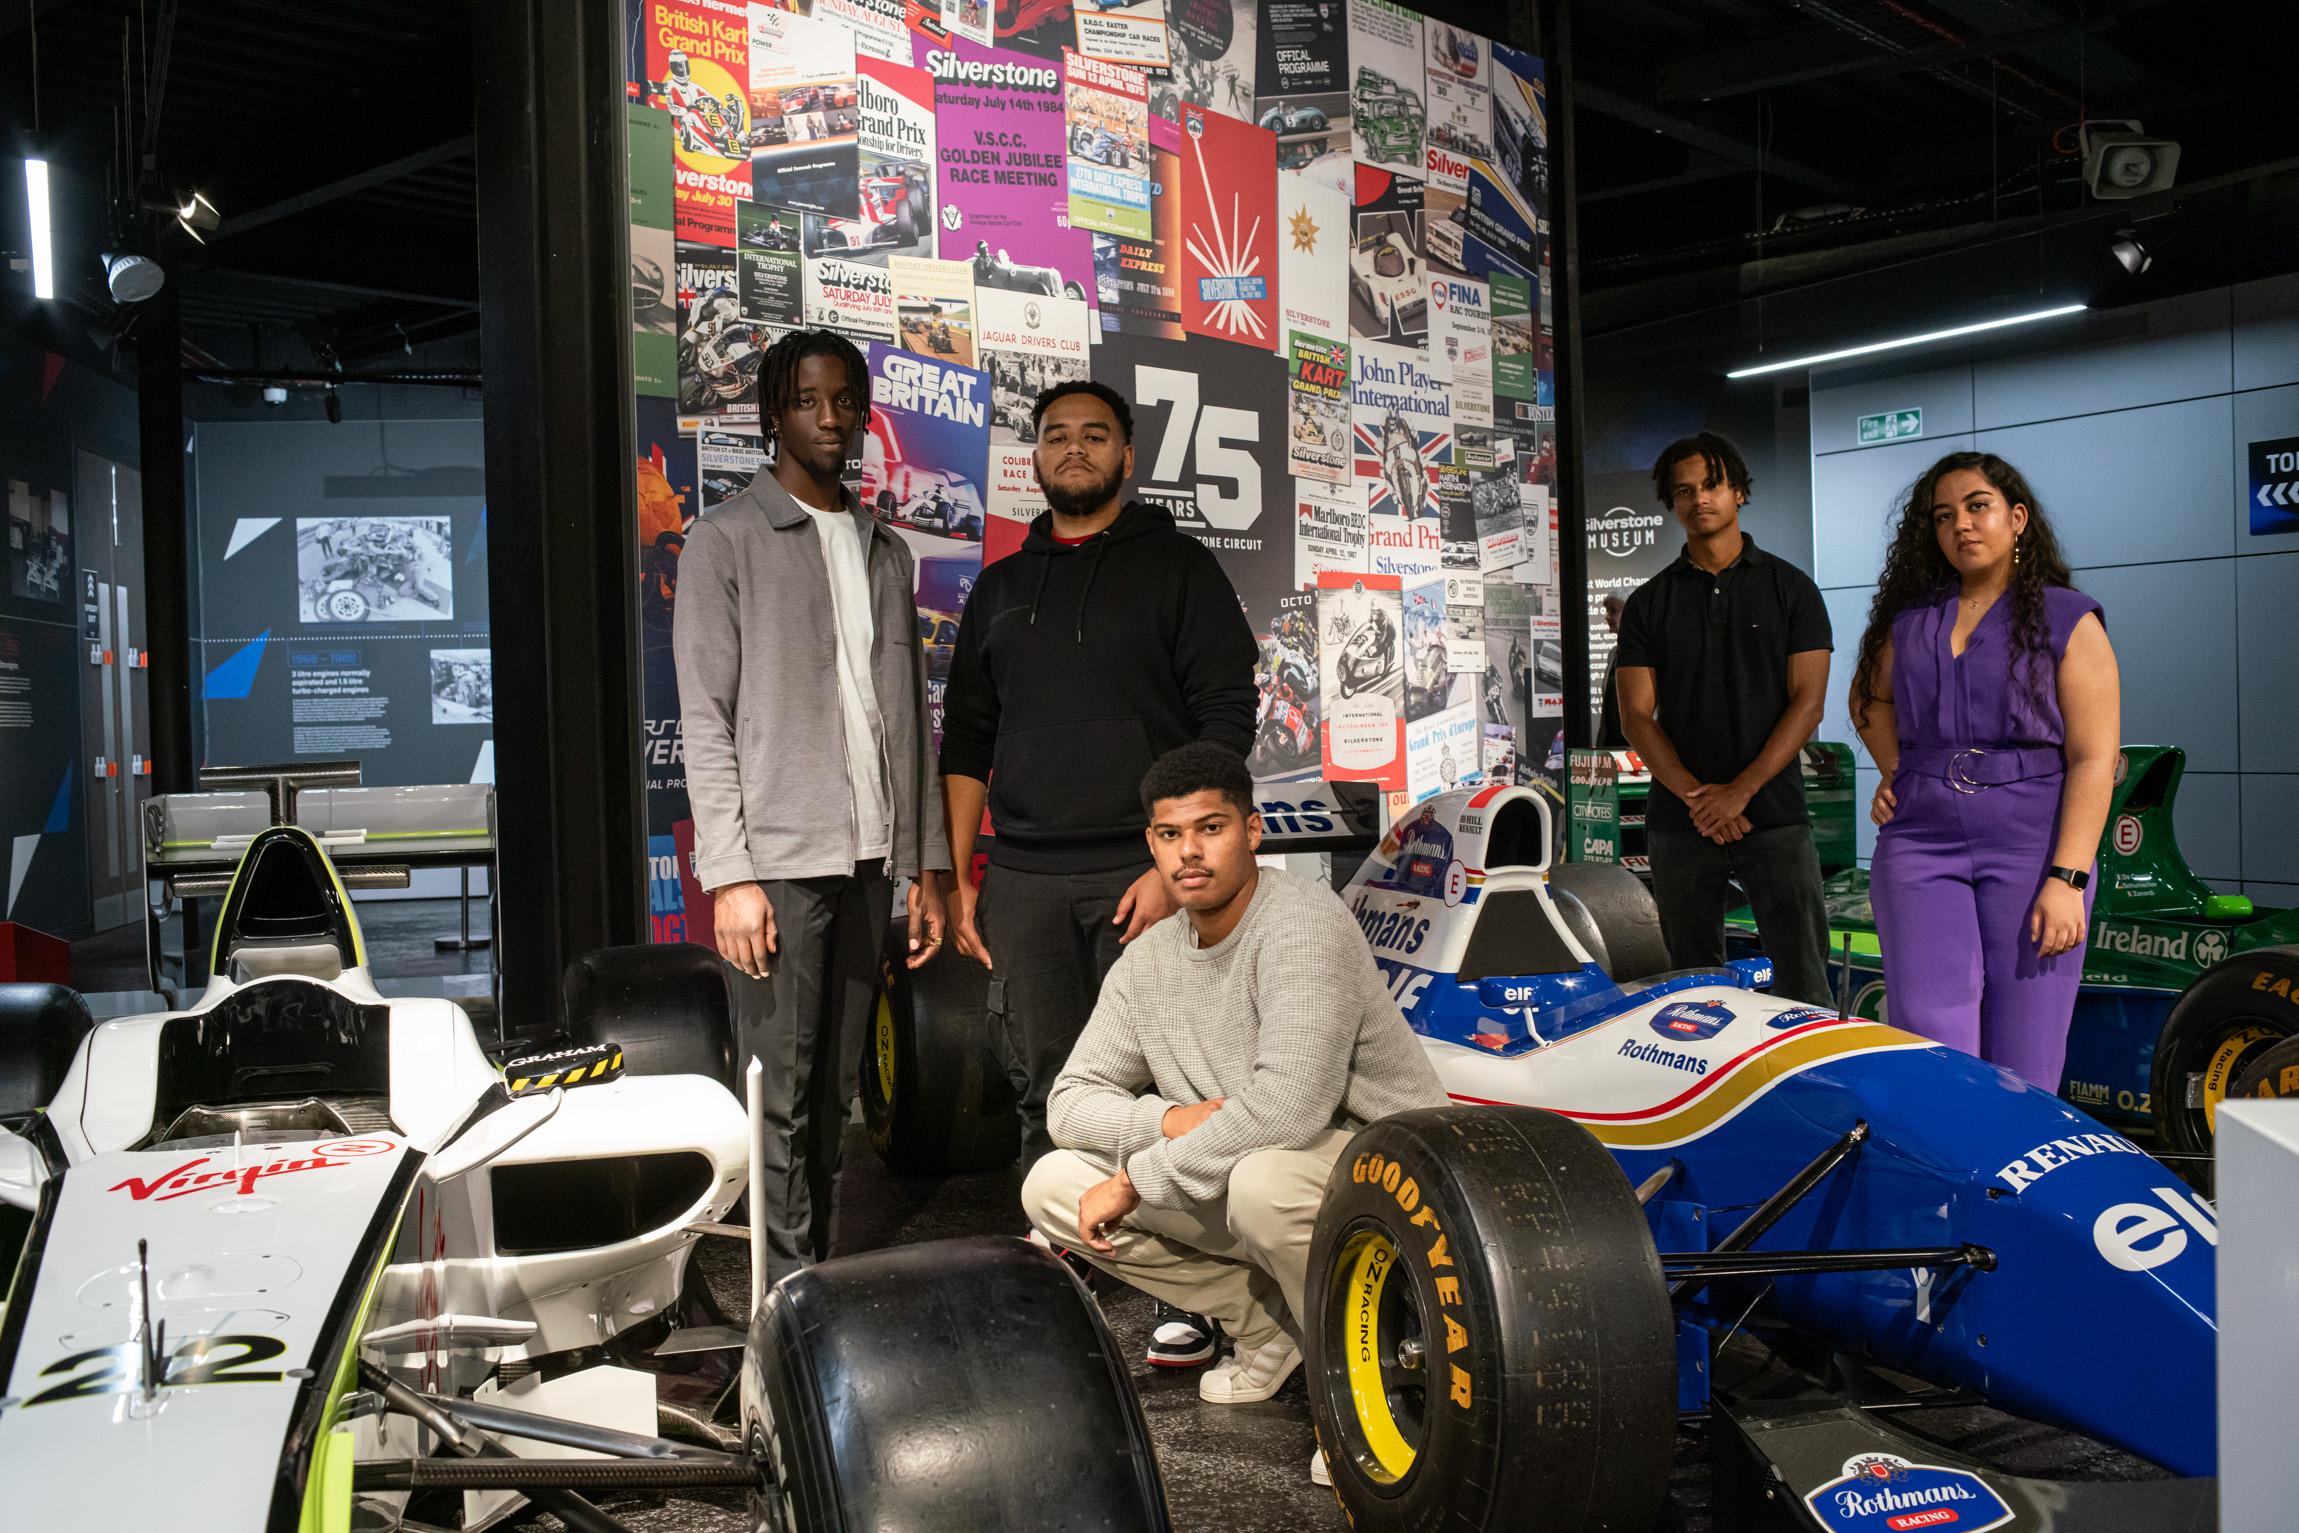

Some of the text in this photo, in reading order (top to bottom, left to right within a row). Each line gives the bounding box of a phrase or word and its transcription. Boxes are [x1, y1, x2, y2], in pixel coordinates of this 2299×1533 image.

[655, 4, 748, 46] British Kart
[1084, 28, 1126, 38] CHAMPIONSHIP
[1142, 35, 1161, 43] RACES
[1106, 22, 1128, 30] EASTER
[659, 27, 746, 65] Grand Prix
[924, 50, 1058, 89] Silverstone
[1066, 53, 1145, 86] SILVERSTONE
[1278, 61, 1330, 74] PROGRAMME
[1067, 66, 1146, 96] SUN 13 APRIL 1975
[936, 93, 1064, 113] aturday July 14th 1984
[896, 115, 927, 145] Prix
[974, 130, 1027, 148] V.S.C.C.
[884, 141, 895, 152] for
[896, 144, 924, 158] Drivers
[940, 148, 1063, 169] GOLDEN JUBILEE
[1427, 149, 1470, 180] Silver
[675, 167, 753, 197] verston
[950, 168, 1058, 187] RACE MEETING
[691, 190, 733, 207] July 30
[743, 252, 798, 268] INTERNATIONAL
[1120, 243, 1153, 258] DAILY
[757, 261, 785, 272] TROPHY
[1120, 257, 1166, 274] EXPRESS
[823, 286, 892, 308] SATURDAY JULY
[1449, 282, 1482, 307] FINA
[1285, 308, 1331, 329] SILVERSTONE
[1449, 304, 1490, 320] RAC TOURIST
[850, 330, 892, 342] CHAMPIONSHIP
[981, 329, 1081, 352] JAGUAR DRIVERS CLUB
[1298, 349, 1331, 365] BRITISH
[883, 354, 978, 398] GREAT
[1300, 361, 1348, 388] KART
[1358, 354, 1396, 386] John
[1292, 379, 1343, 401] GRAND PRIX
[1351, 380, 1450, 417] International
[726, 403, 755, 413] BRITISH
[873, 375, 985, 428] BRITAIN
[1454, 400, 1491, 414] SILVERSTONE
[1135, 364, 1262, 530] 75
[1292, 445, 1347, 468] Silverstone
[1466, 452, 1492, 463] Autocar
[701, 454, 756, 466] SILVERSTONE
[1002, 455, 1032, 467] COLIBR
[2266, 451, 2299, 474] TO
[1003, 468, 1027, 479] RACE
[997, 483, 1021, 493] Saturday
[1313, 505, 1351, 528] Marlboro
[1223, 537, 1263, 550] CIRCUIT
[1299, 520, 1366, 549] International Trophy
[1417, 525, 1441, 550] Pri
[1587, 530, 1655, 549] MUSEUM
[1307, 544, 1325, 554] SUNDAY
[1325, 547, 1338, 556] APRIL
[1594, 577, 1621, 589] World
[1343, 737, 1384, 745] SILVERSTONE
[1408, 729, 1447, 753] Grand Prix
[1254, 799, 1334, 834] ns
[1466, 815, 1483, 826] HILL
[1459, 824, 1483, 835] RENAULT
[2120, 824, 2134, 845] E
[1584, 837, 1614, 856] CAPA
[1450, 874, 1460, 894] E
[2096, 921, 2189, 960] Ireland
[1753, 968, 1772, 983] elf
[1504, 986, 1533, 1001] elf
[1664, 1002, 1722, 1027] Rothmans
[1672, 1021, 1696, 1032] RACING
[507, 1044, 607, 1066] GRAHAM
[1617, 1038, 1709, 1076] Rothmans
[2208, 1048, 2234, 1092] Racing
[2069, 1080, 2110, 1098] FIAMM
[2246, 1065, 2299, 1099] AR
[1995, 1133, 2158, 1194] RENAU
[106, 1157, 352, 1201] Virgin
[2093, 1188, 2219, 1272] el
[1352, 1152, 1473, 1410] GOODYEAR
[1359, 1282, 1374, 1363] RACING
[20, 1335, 286, 1408] 22
[1835, 1482, 1977, 1519] Rothmans
[1896, 1510, 1951, 1529] RACING
